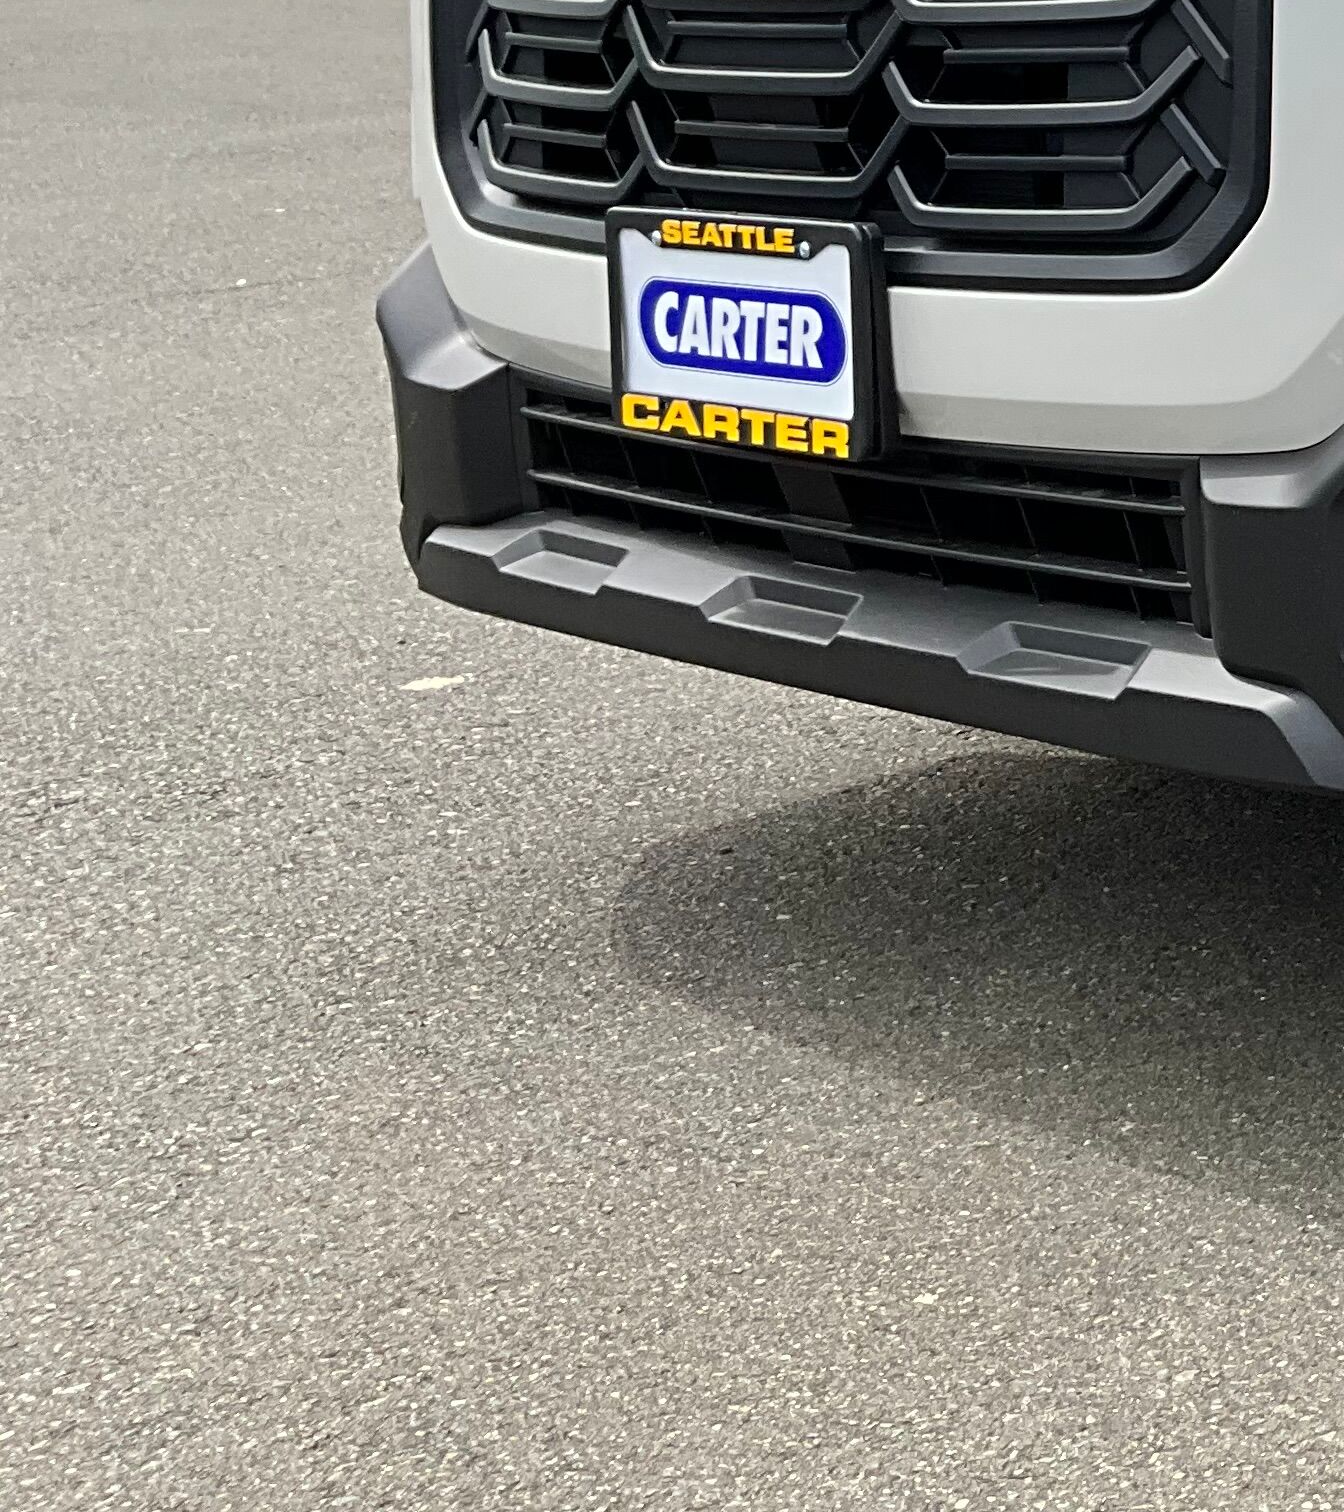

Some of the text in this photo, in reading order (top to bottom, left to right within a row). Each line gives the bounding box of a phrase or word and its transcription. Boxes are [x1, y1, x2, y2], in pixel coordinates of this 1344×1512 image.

[661, 219, 795, 253] SEATTLE
[654, 290, 823, 369] CARTER
[622, 393, 849, 458] CARTER
